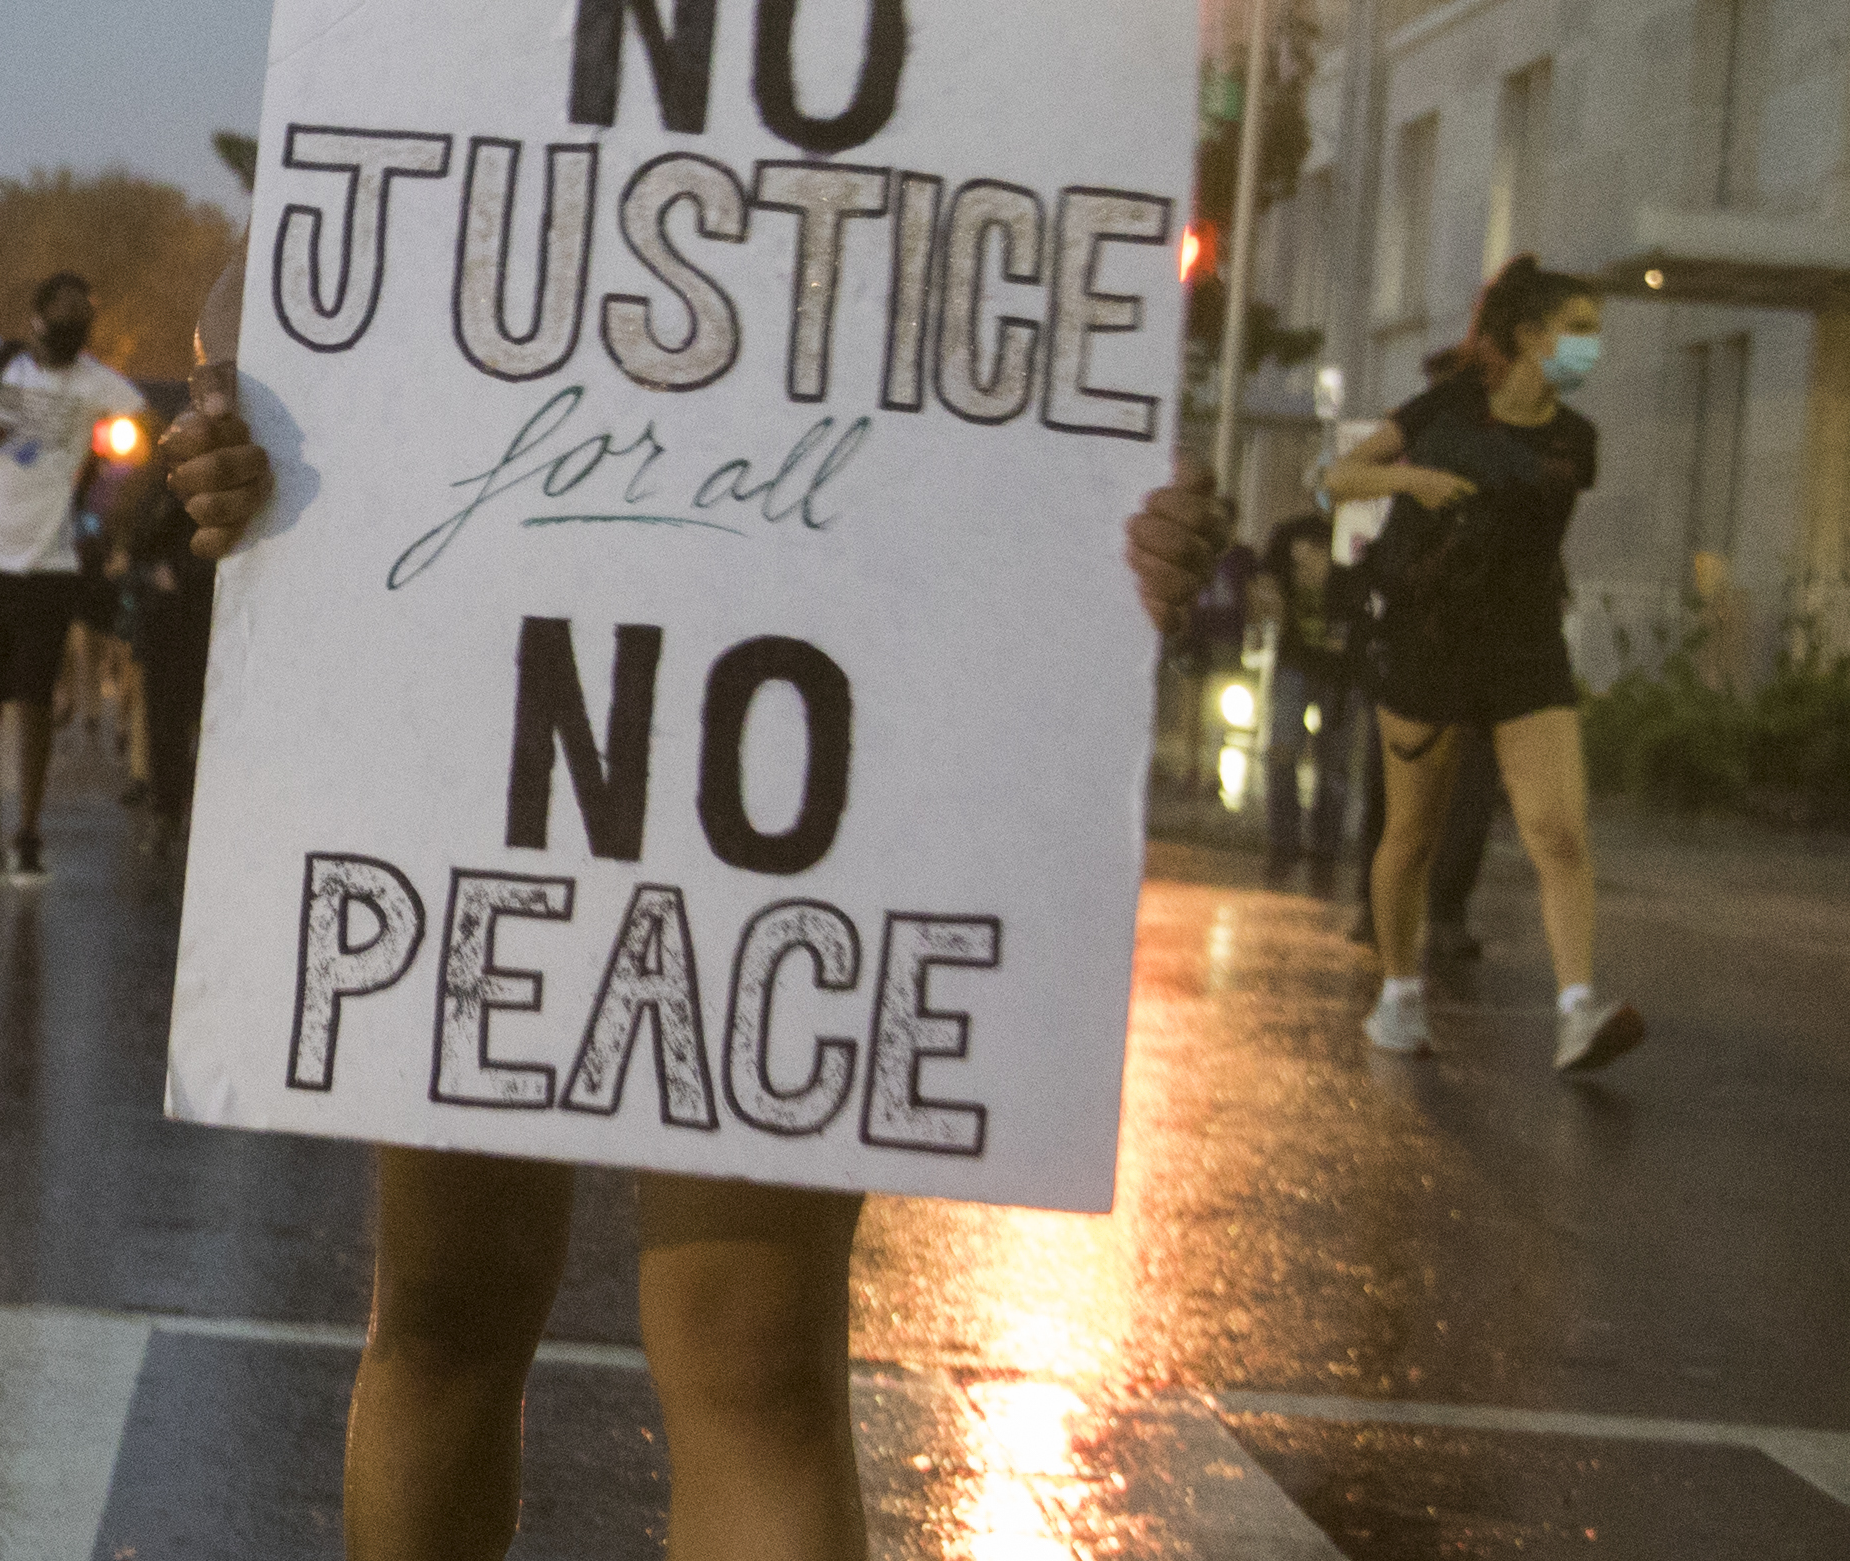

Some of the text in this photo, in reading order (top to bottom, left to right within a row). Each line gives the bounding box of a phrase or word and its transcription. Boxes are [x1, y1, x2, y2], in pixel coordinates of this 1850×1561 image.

[271, 123, 1175, 440] JUSTICE
[386, 385, 873, 590] for all
[504, 615, 852, 875] NO
[286, 853, 1001, 1156] PEACE
